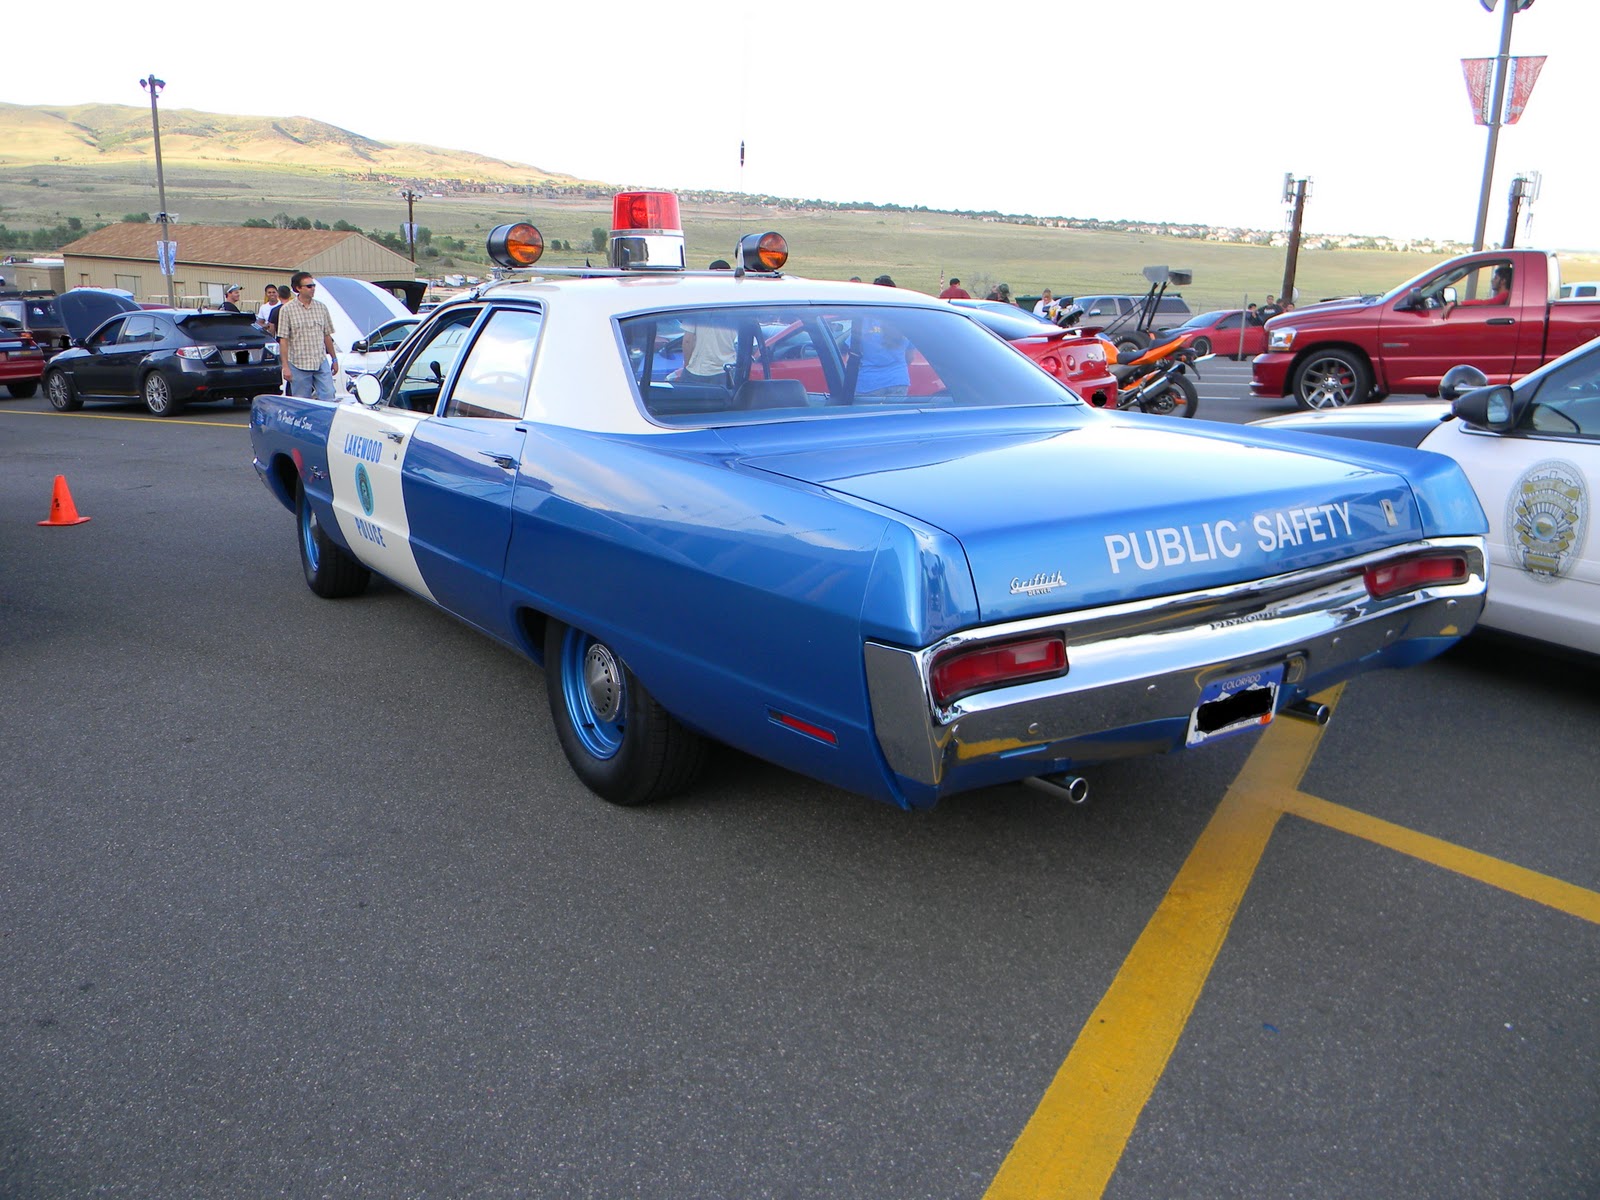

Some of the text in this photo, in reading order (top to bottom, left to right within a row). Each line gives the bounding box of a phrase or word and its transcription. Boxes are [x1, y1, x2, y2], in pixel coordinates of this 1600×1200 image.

[343, 433, 383, 464] LAKEWOOD
[354, 517, 387, 548] POLICE
[1104, 501, 1352, 575] PUBLIC SAFETY
[1010, 570, 1065, 592] Griffith
[1027, 588, 1054, 598] DENVER
[1222, 673, 1261, 691] COLORADO
